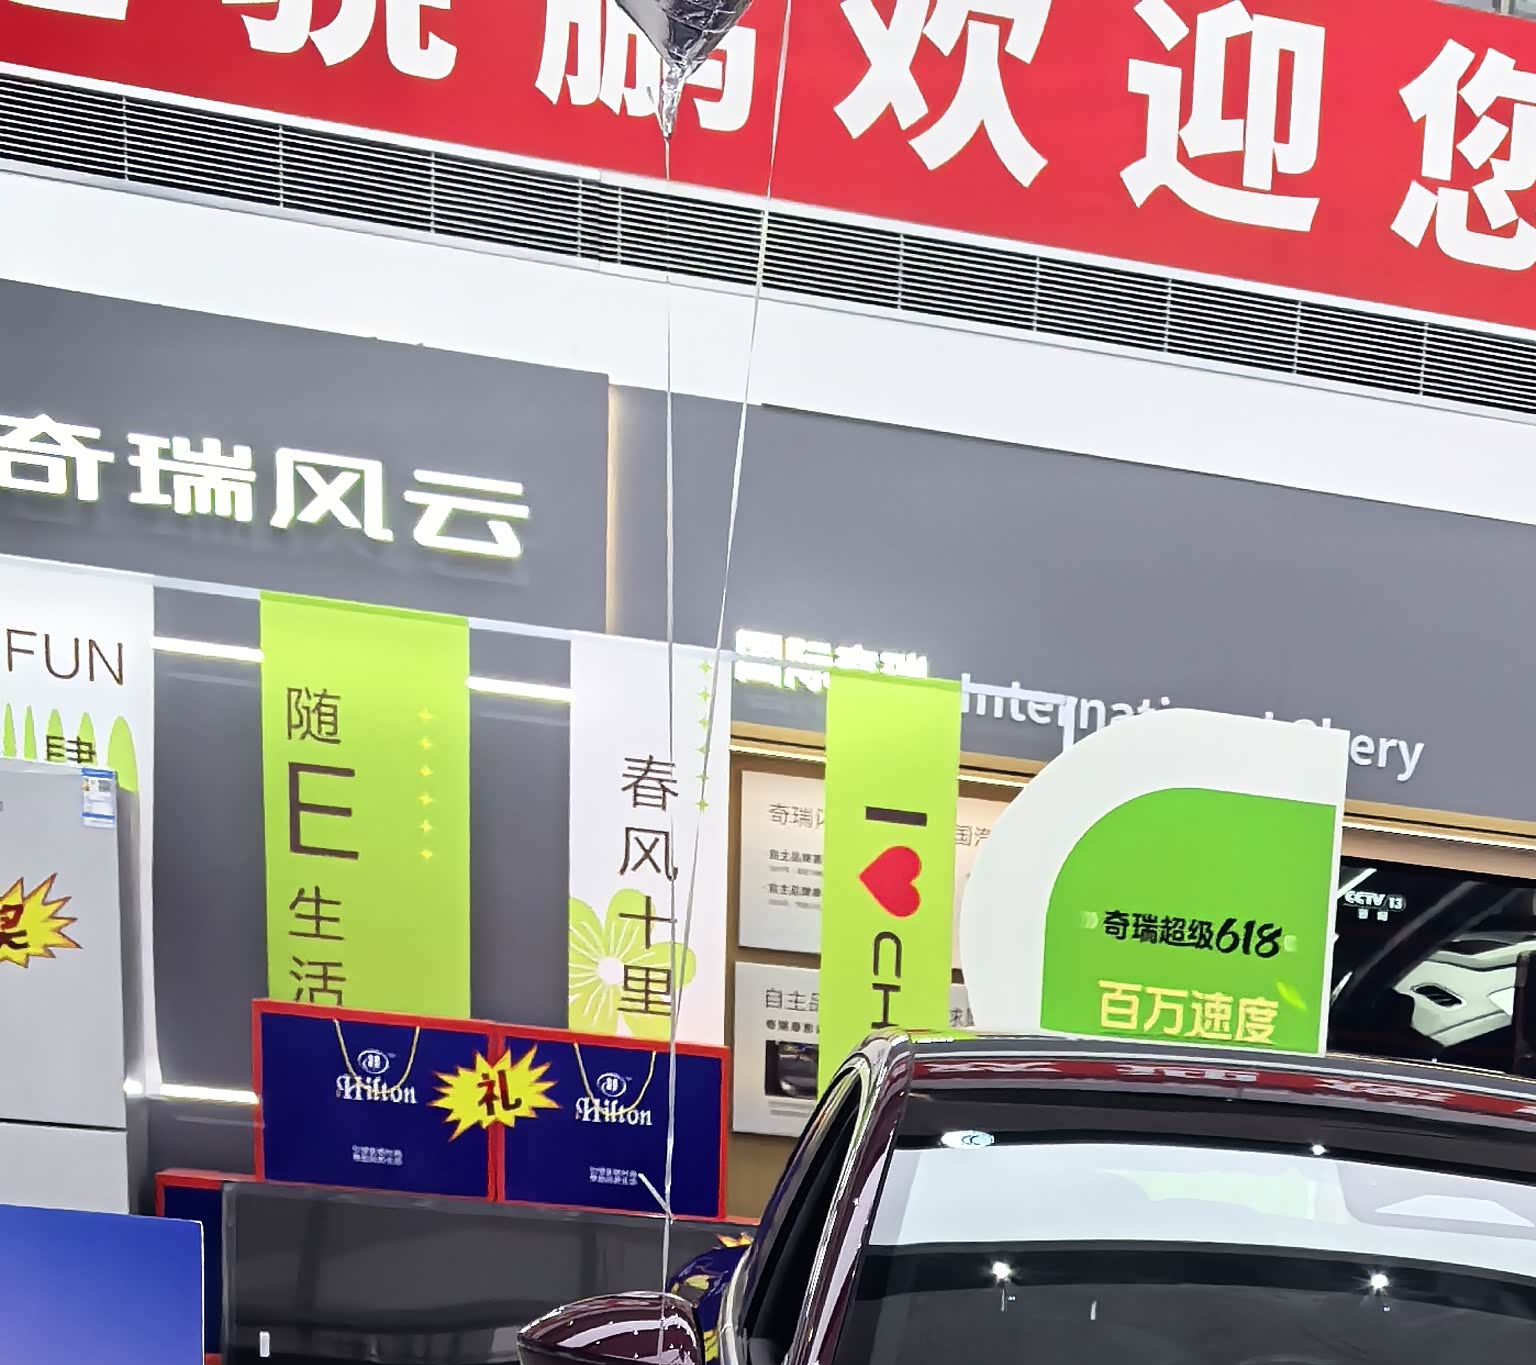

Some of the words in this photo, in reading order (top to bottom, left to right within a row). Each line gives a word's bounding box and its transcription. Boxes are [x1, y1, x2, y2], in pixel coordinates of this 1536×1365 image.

[0, 414, 530, 559] 奇瑞风云
[6, 628, 124, 686] FUN
[616, 754, 679, 1016] 春风十里
[1344, 890, 1386, 906] CCTV
[1103, 909, 1283, 958] 奇瑞超级618
[1098, 978, 1279, 1045] 百万速度
[336, 1074, 418, 1105] Hilton
[477, 1069, 523, 1116] 礼
[575, 1096, 653, 1127] Hilton
